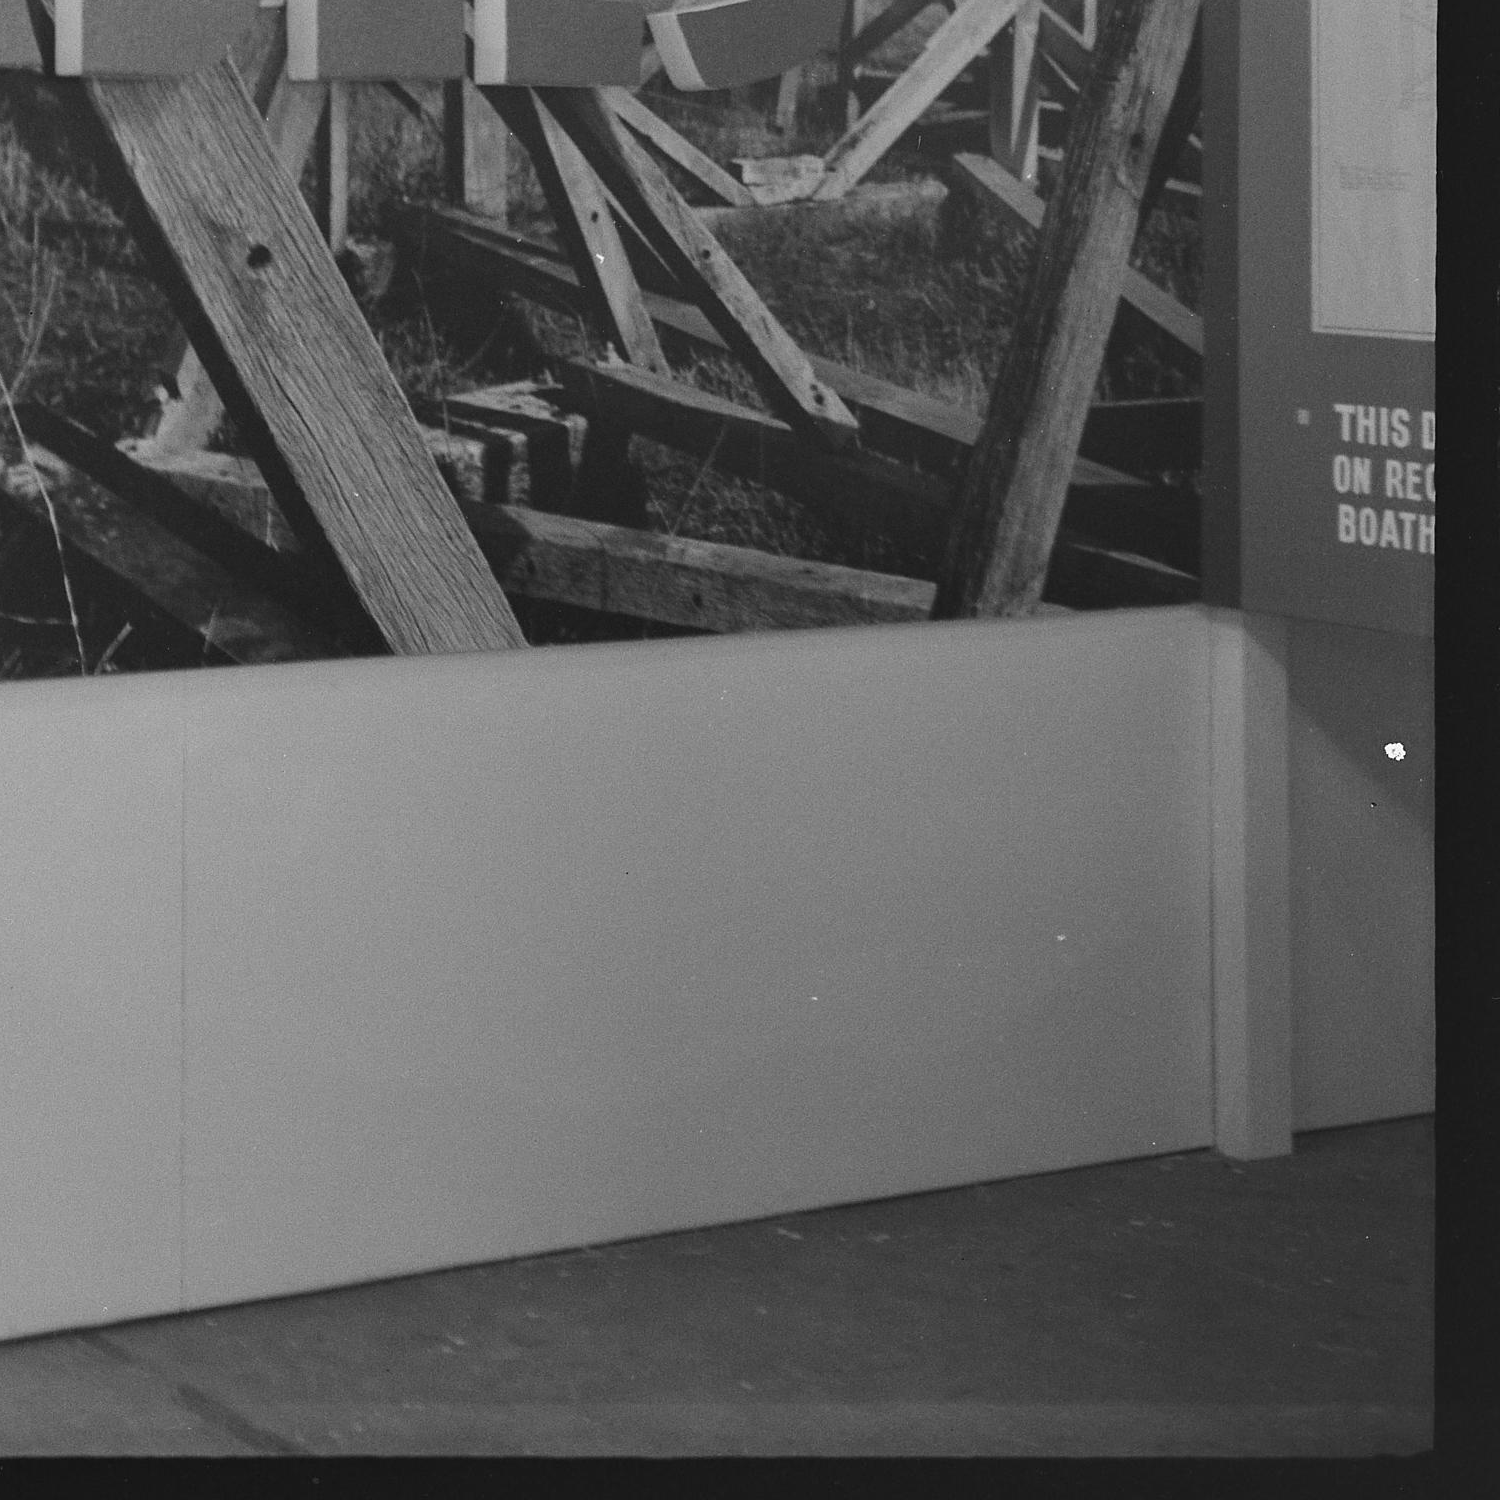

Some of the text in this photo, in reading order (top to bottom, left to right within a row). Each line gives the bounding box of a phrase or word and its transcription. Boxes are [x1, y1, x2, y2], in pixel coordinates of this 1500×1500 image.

[1333, 403, 1411, 449] THIS
[1332, 454, 1372, 495] ON
[1338, 503, 1436, 556] BOATH
